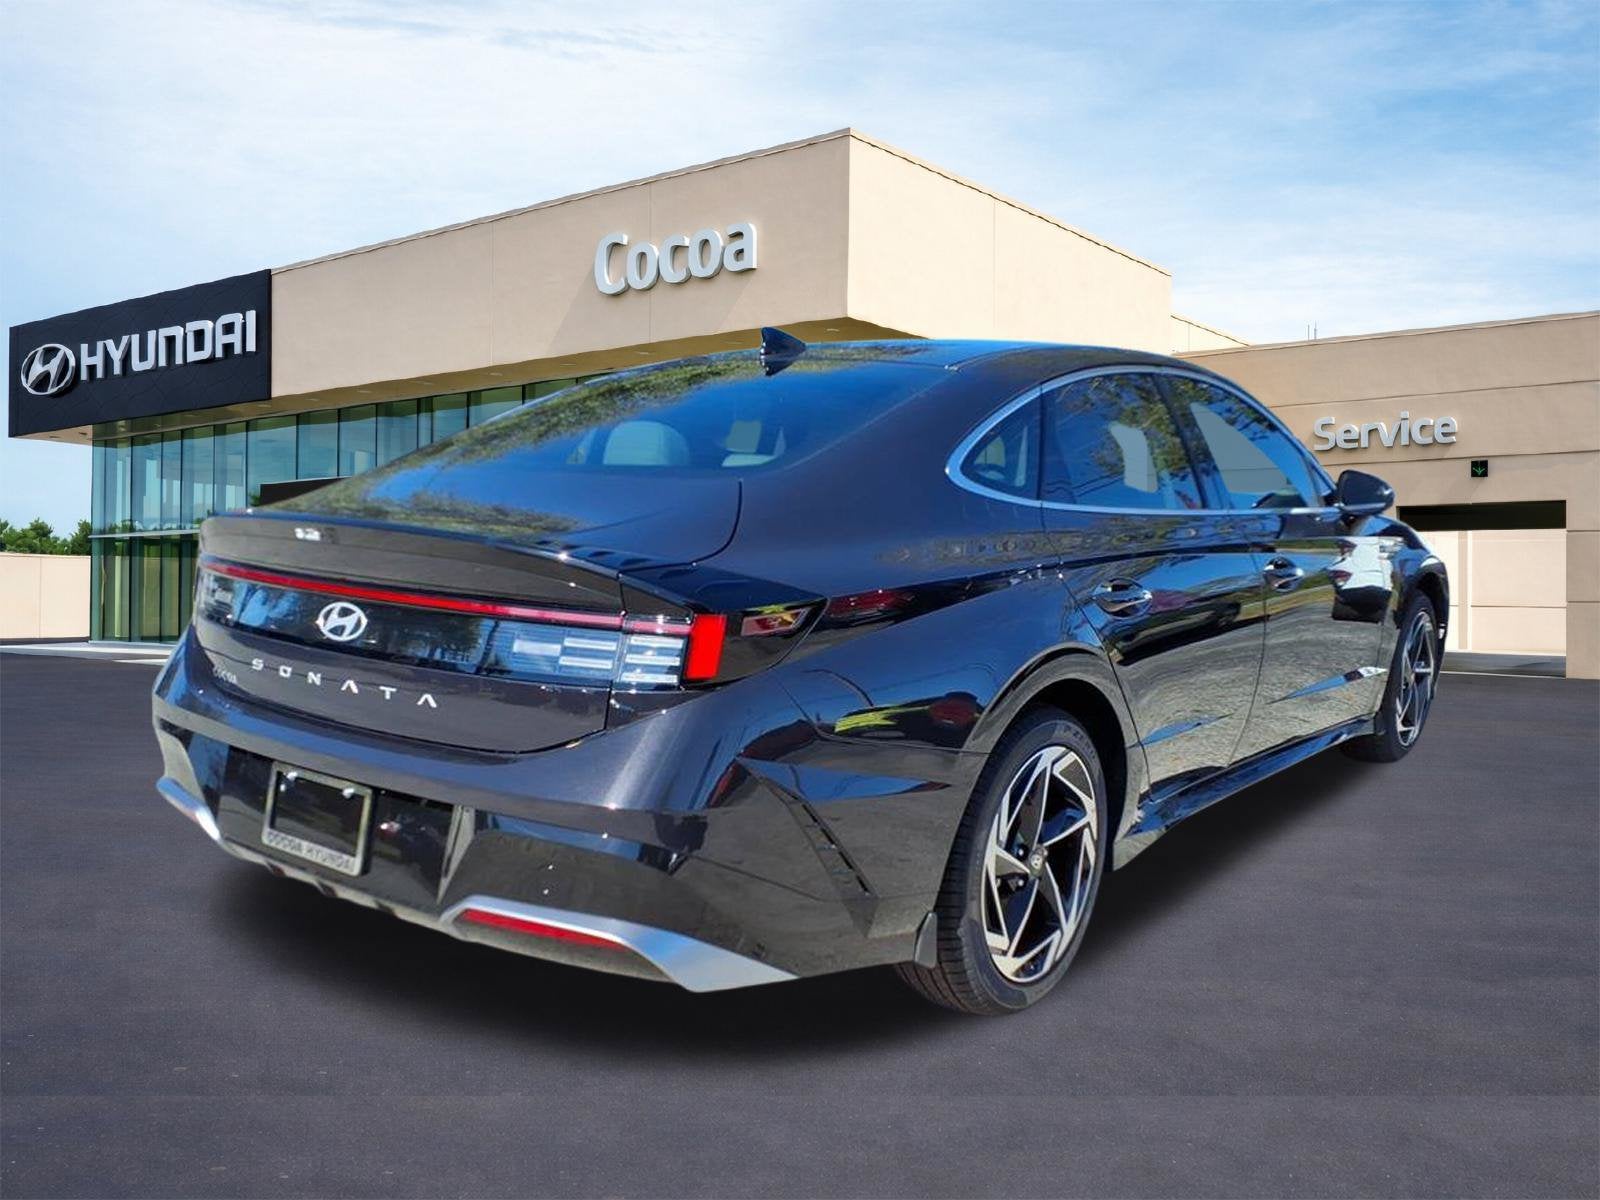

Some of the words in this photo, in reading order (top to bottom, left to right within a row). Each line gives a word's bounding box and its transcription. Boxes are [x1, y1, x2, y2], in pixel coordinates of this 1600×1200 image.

[594, 222, 758, 296] Cocoa
[80, 310, 257, 381] HYUNDAI
[1313, 411, 1458, 451] Service
[251, 658, 438, 709] SONATA
